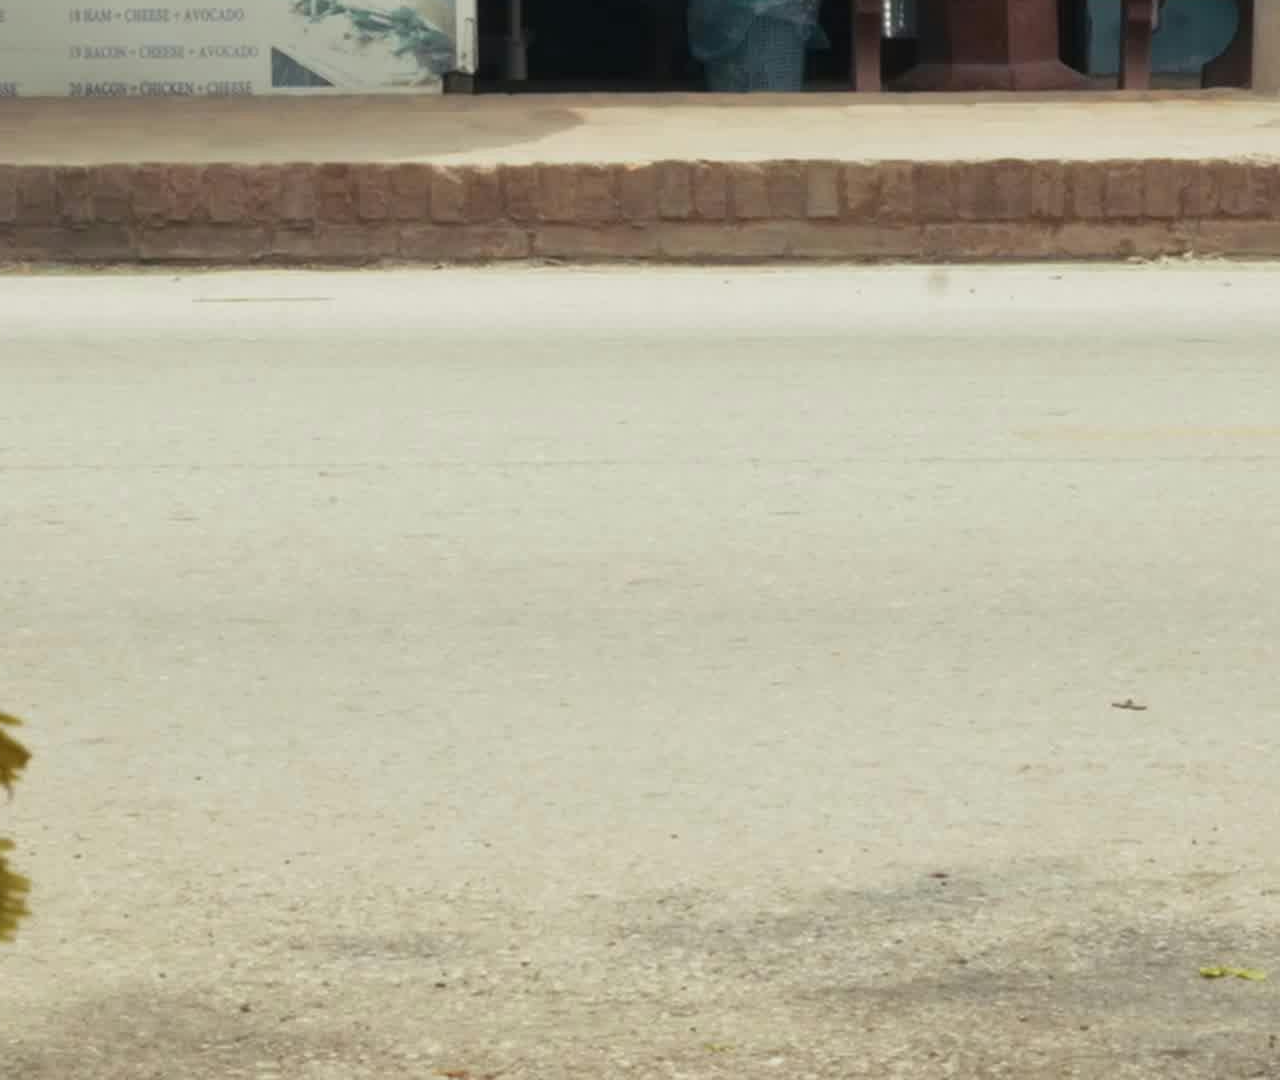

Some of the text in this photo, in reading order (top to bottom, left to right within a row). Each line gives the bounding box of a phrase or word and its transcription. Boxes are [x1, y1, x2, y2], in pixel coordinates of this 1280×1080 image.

[183, 8, 245, 22] AVOCADO
[198, 45, 259, 59] AVOCADO
[140, 82, 194, 96] CHICKEN
